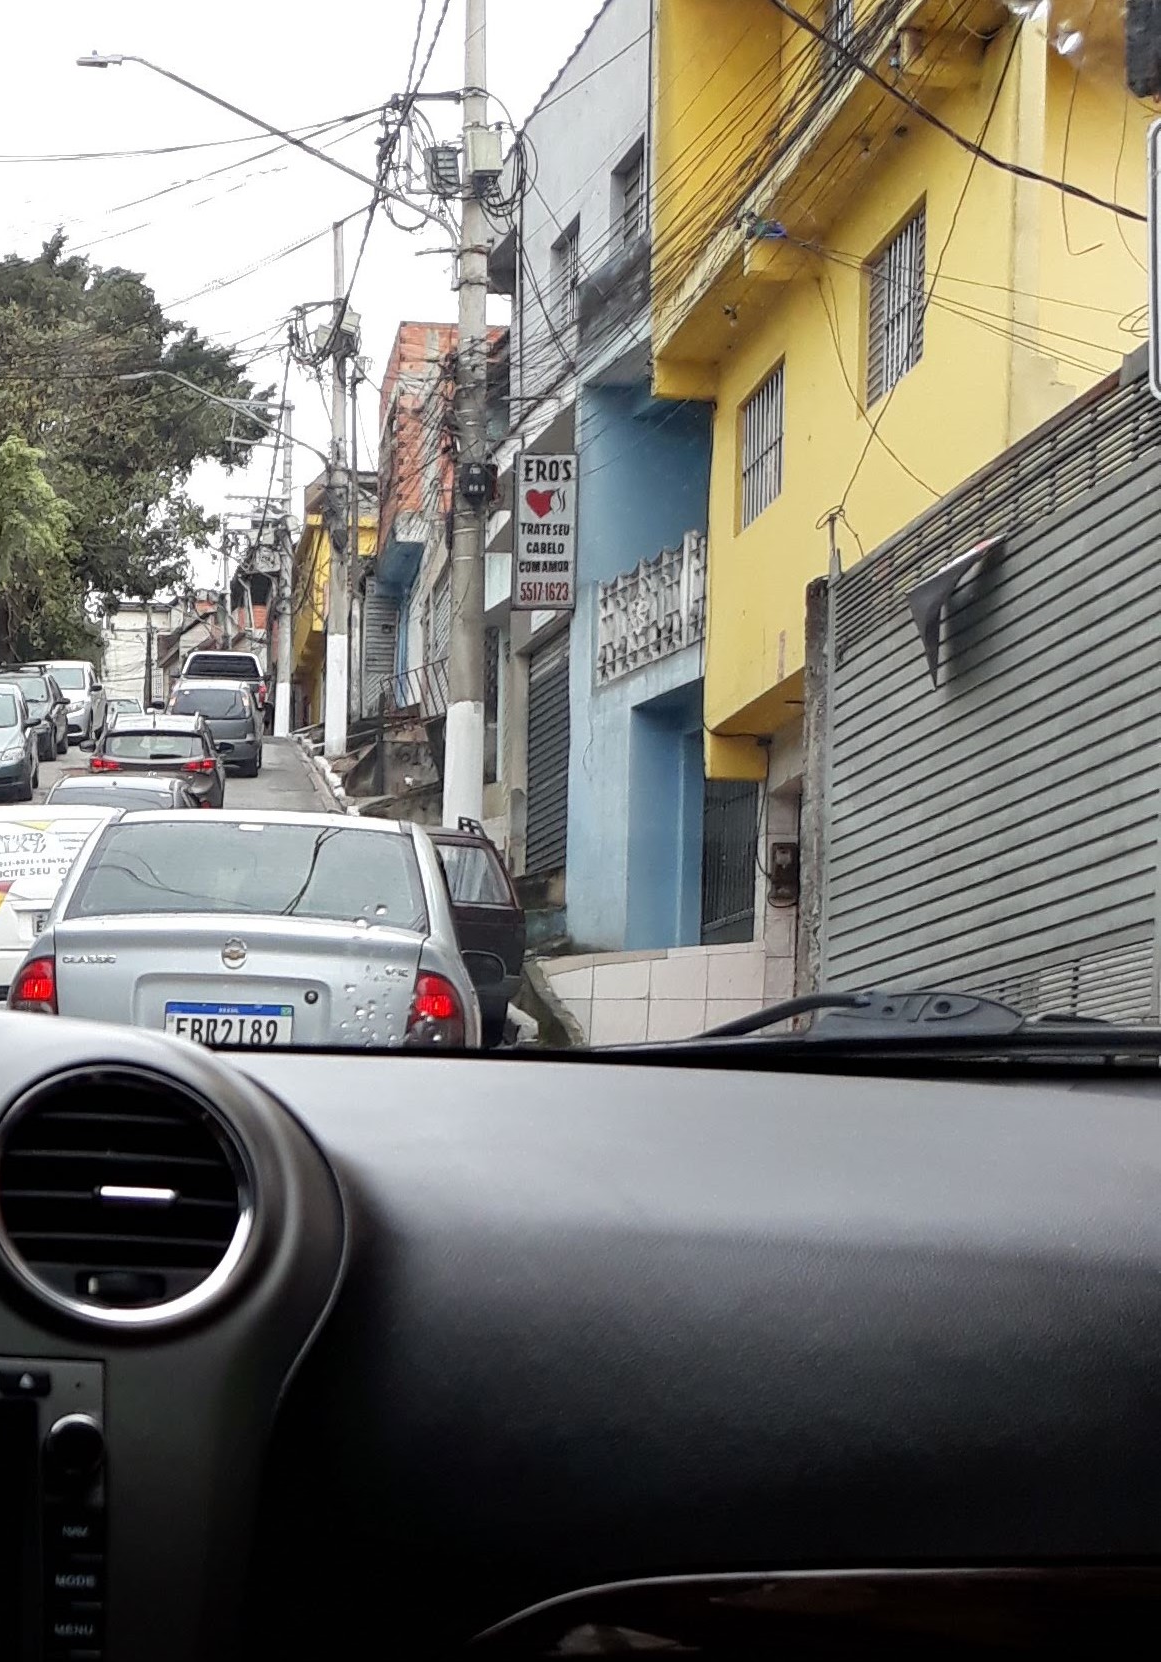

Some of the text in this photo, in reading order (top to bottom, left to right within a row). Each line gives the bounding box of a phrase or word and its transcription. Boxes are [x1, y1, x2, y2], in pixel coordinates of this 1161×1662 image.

[523, 459, 572, 482] ERO'S
[520, 523, 570, 536] TRATE SEU
[526, 542, 565, 555] CABELO
[519, 561, 570, 573] COM AMOR
[29, 867, 51, 877] SEU
[55, 1573, 96, 1589] MODE
[54, 1622, 94, 1638] MENU
